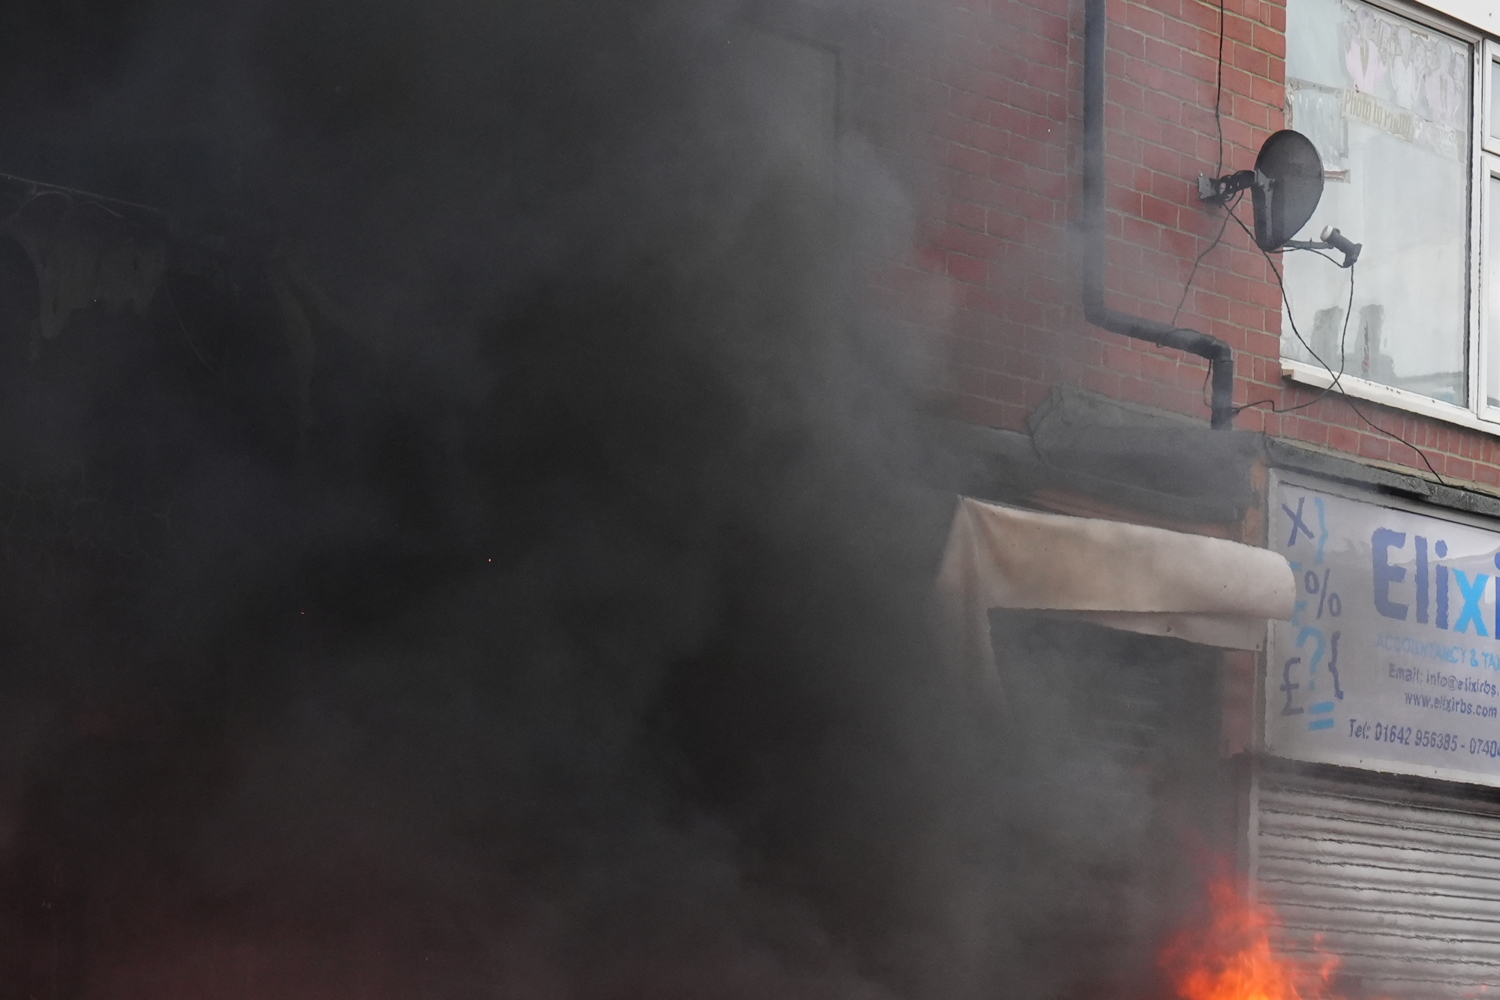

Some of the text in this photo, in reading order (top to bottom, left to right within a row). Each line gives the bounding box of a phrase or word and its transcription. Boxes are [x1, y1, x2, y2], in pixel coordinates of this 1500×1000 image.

[1388, 663, 1423, 684] Email:
[1349, 718, 1371, 740] Tel:
[1374, 721, 1412, 746] 01642
[1414, 729, 1458, 752] 956385
